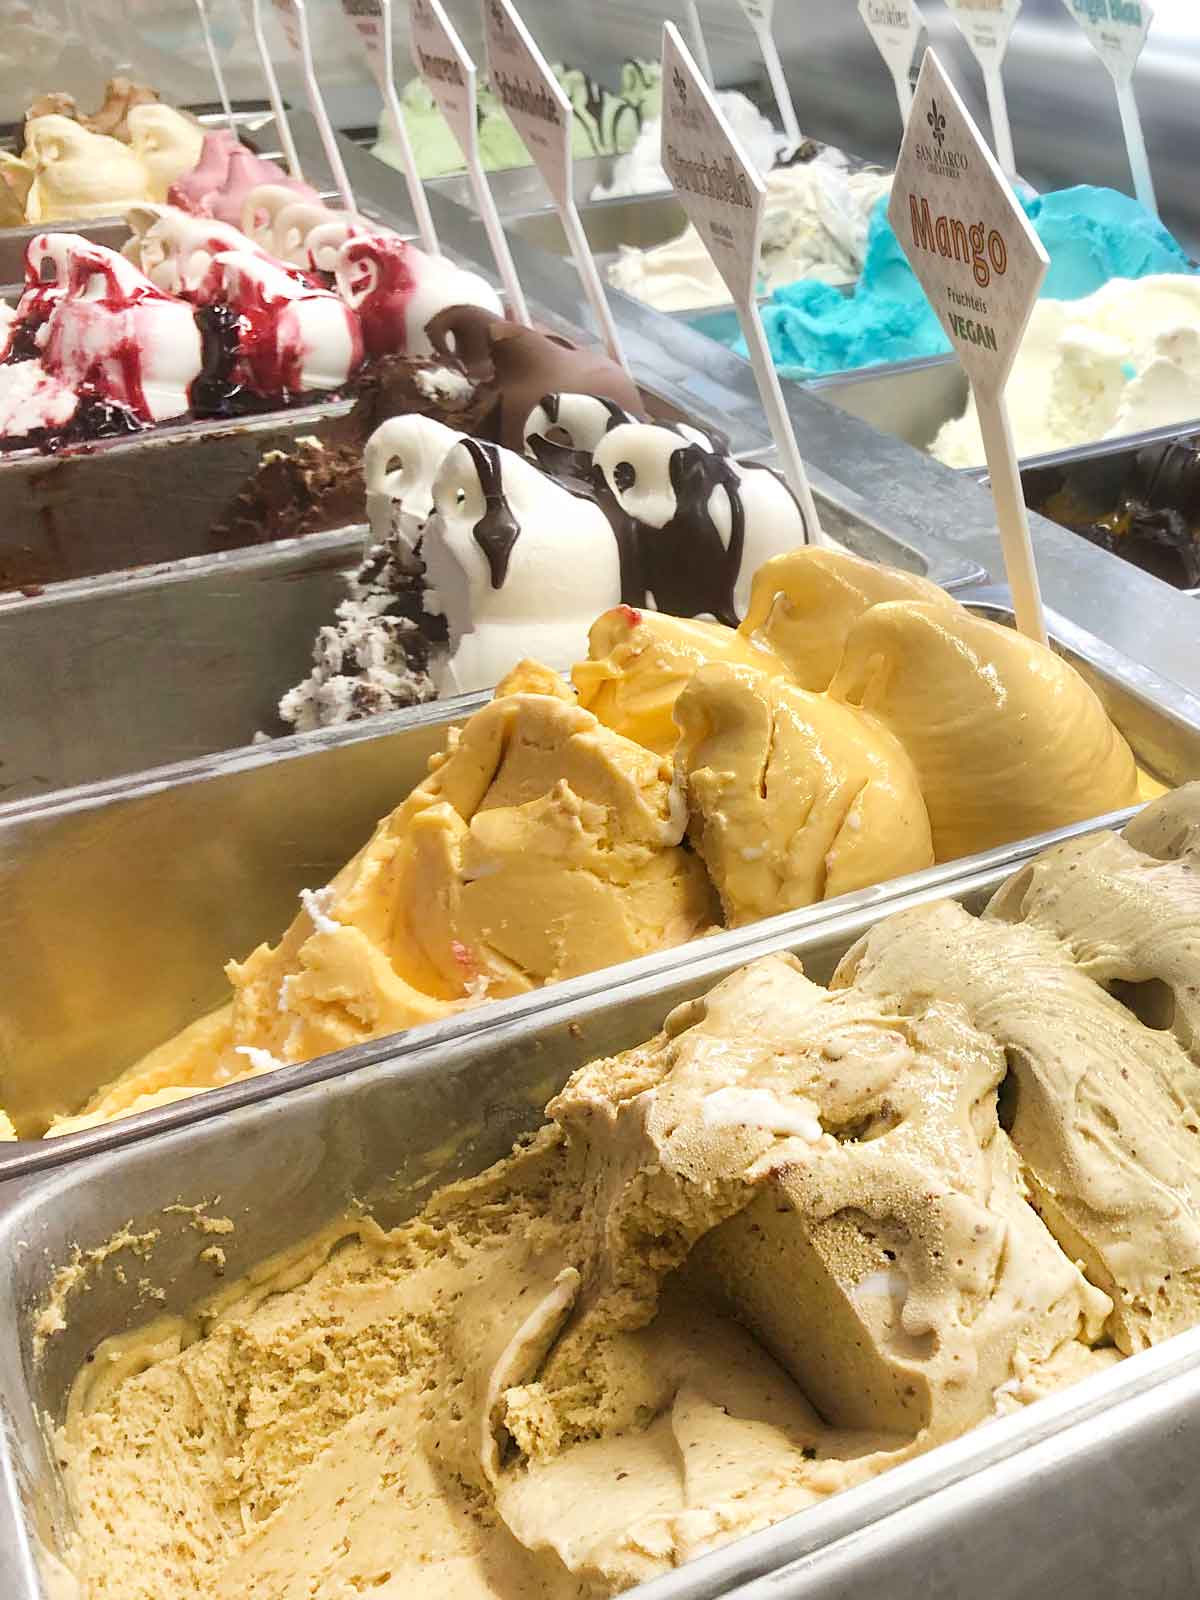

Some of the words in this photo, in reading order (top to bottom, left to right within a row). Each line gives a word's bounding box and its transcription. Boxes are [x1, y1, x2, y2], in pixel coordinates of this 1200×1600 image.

[915, 144, 935, 163] SAN
[934, 147, 968, 170] MARCO
[909, 193, 1007, 288] Mango
[947, 287, 988, 314] Fruchteis
[948, 312, 998, 352] VEGAN
